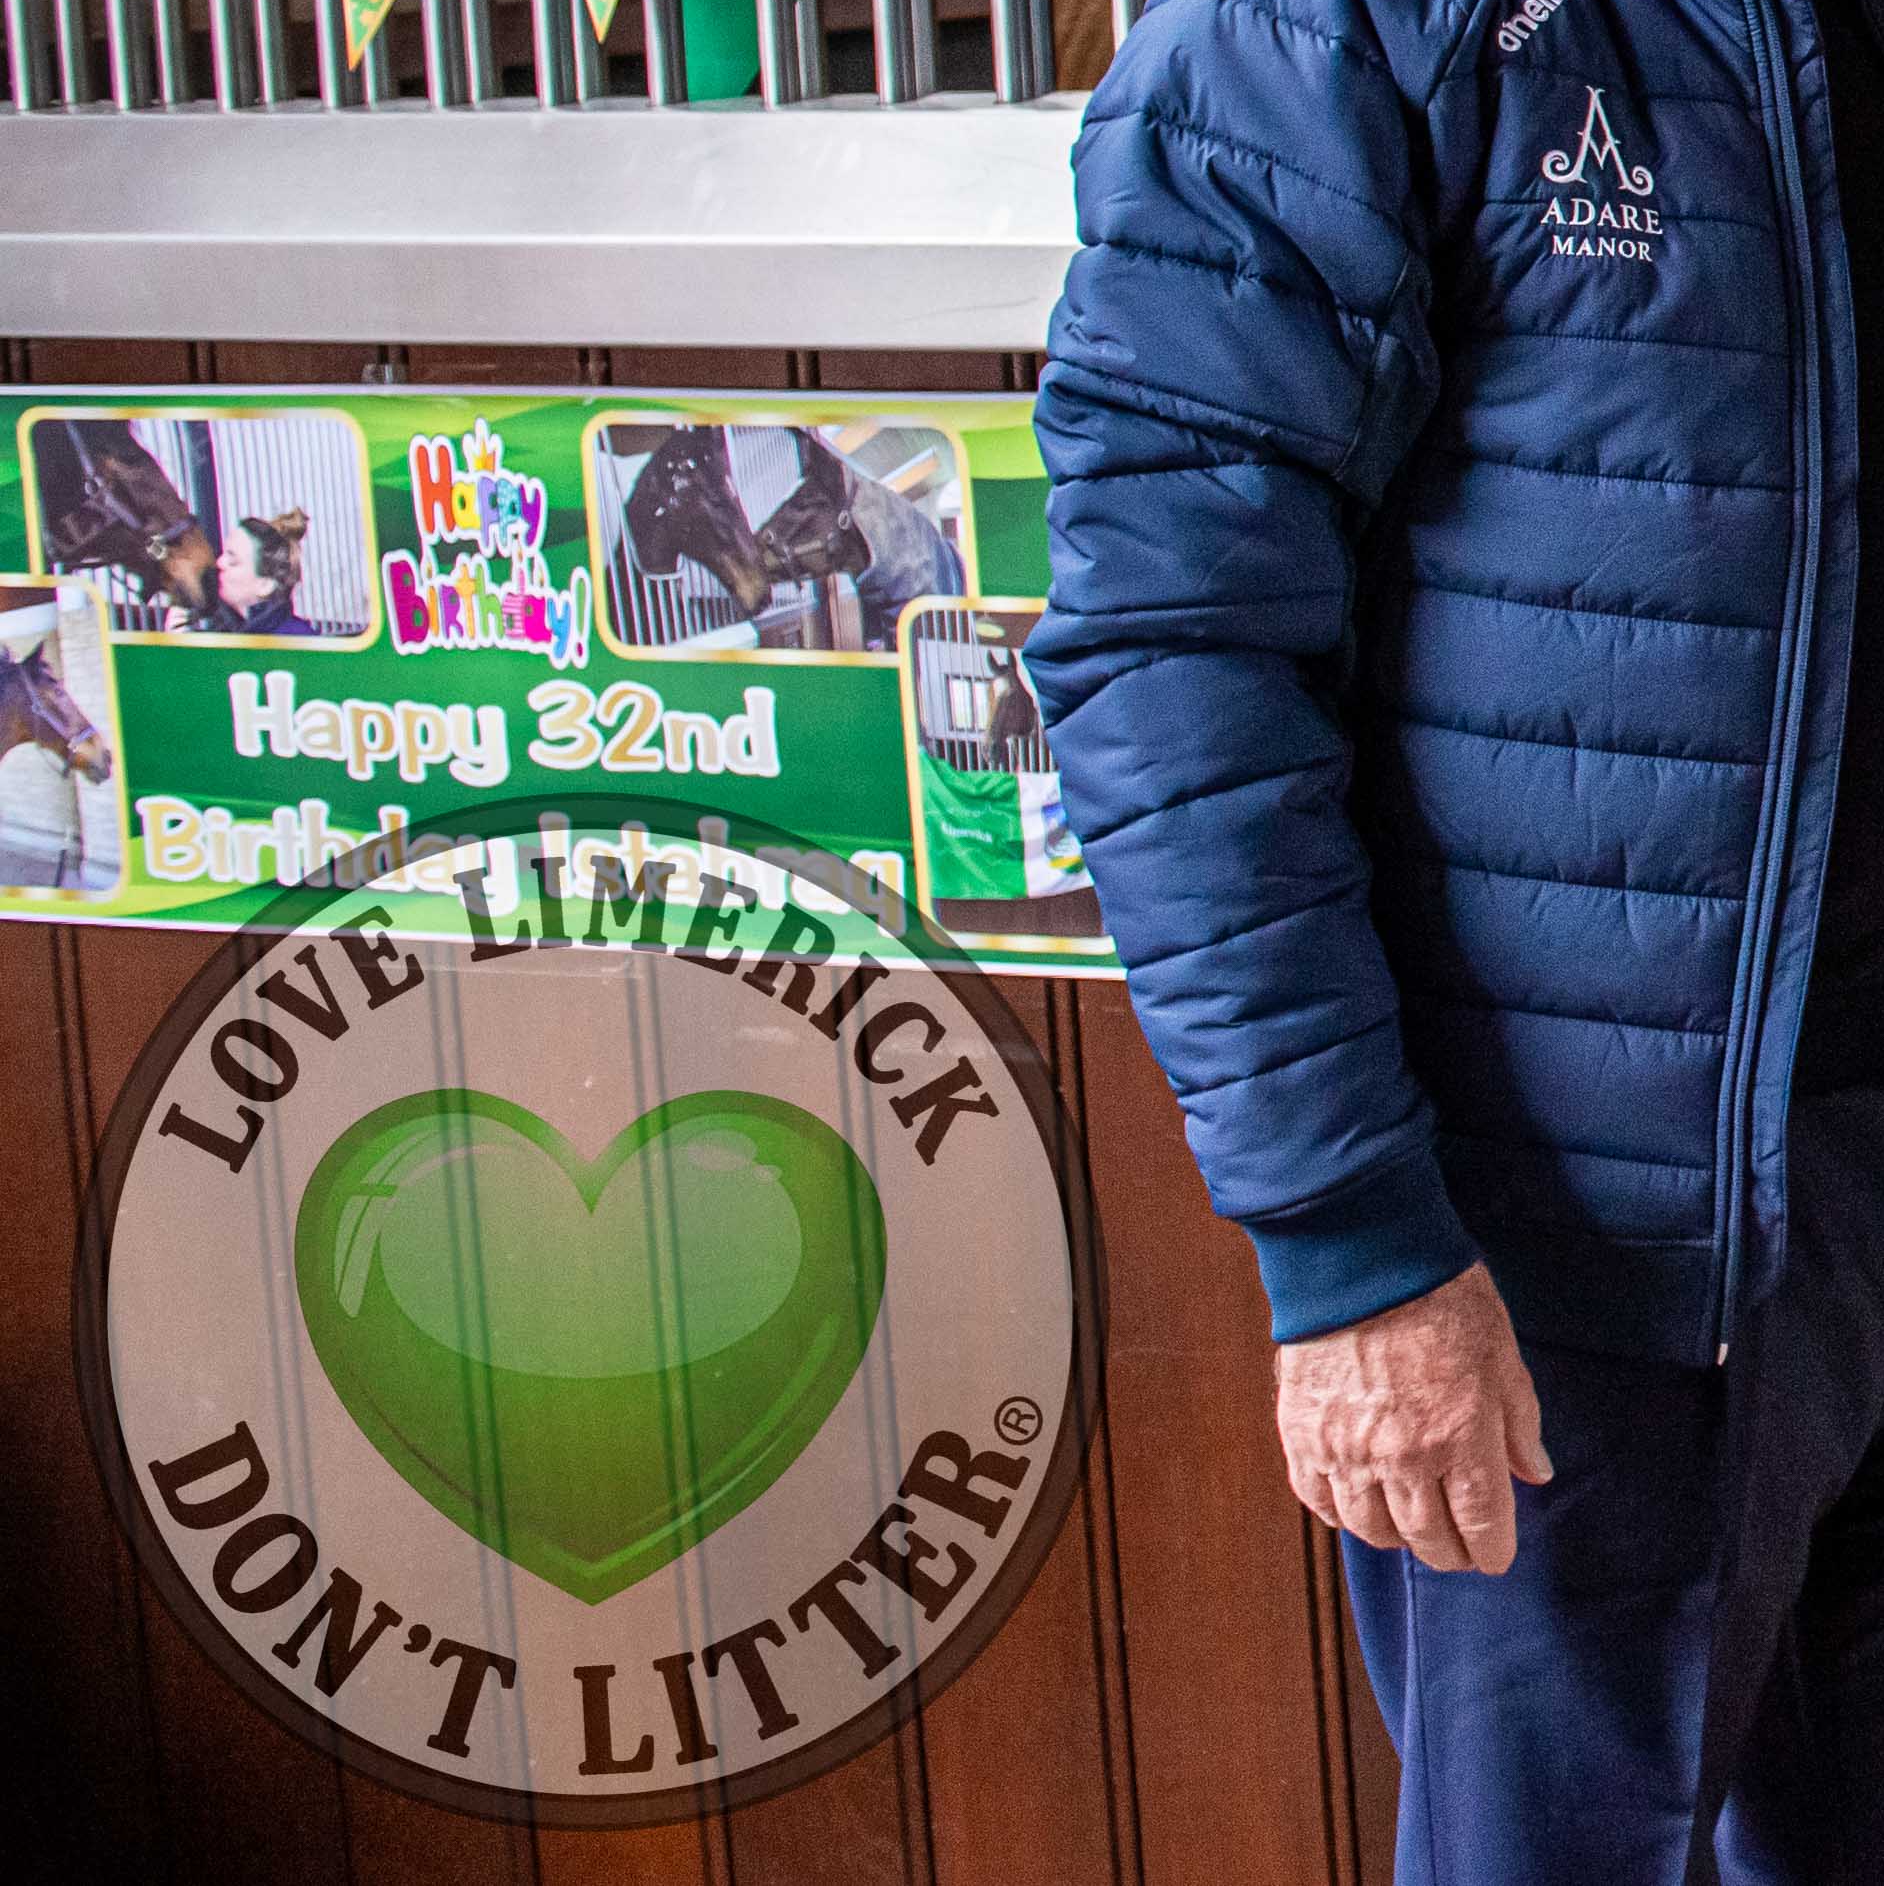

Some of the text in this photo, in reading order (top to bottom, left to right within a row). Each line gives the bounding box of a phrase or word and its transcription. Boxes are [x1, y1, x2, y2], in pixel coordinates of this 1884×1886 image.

[1540, 196, 1664, 235] ADARE
[1552, 234, 1653, 262] MANOR
[411, 435, 546, 556] Happy
[229, 672, 779, 784] Happy 32nd
[134, 794, 908, 938] Birthday Istabraq
